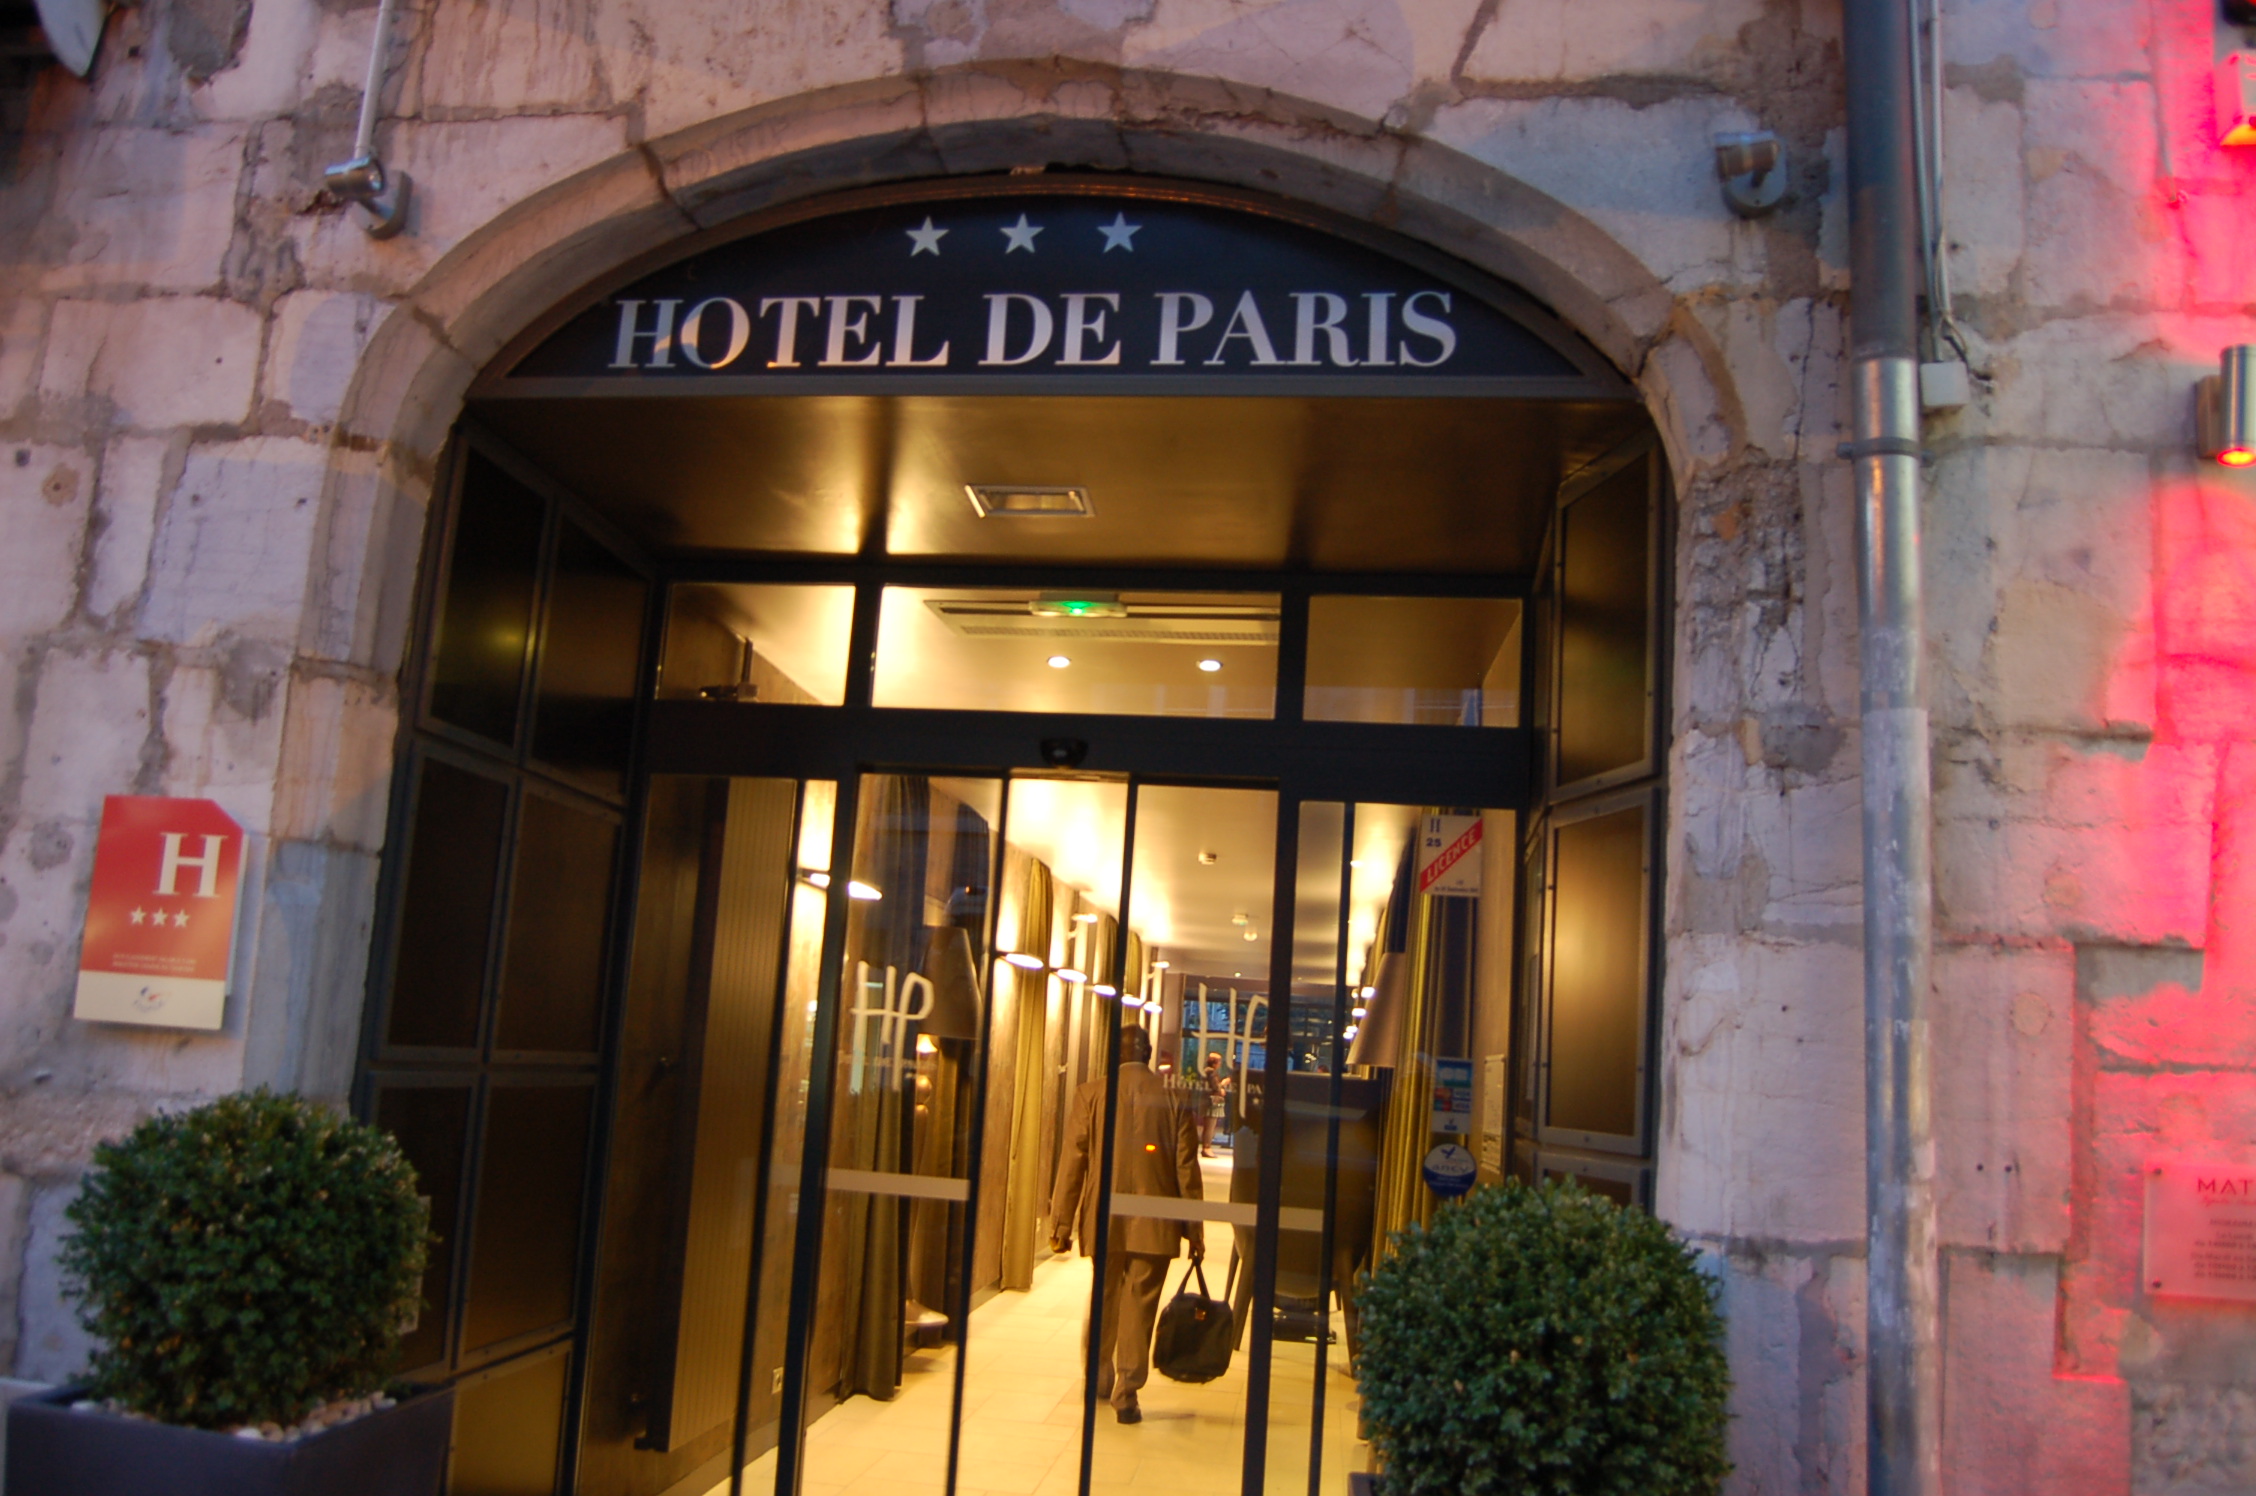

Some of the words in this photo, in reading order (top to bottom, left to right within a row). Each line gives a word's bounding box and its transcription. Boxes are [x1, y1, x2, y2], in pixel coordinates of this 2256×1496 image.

[607, 295, 949, 369] HOTEL
[978, 291, 1121, 366] DE
[1150, 290, 1456, 367] PARIS
[153, 832, 229, 897] H
[1426, 837, 1442, 847] 25
[1426, 827, 1476, 882] LICENCE
